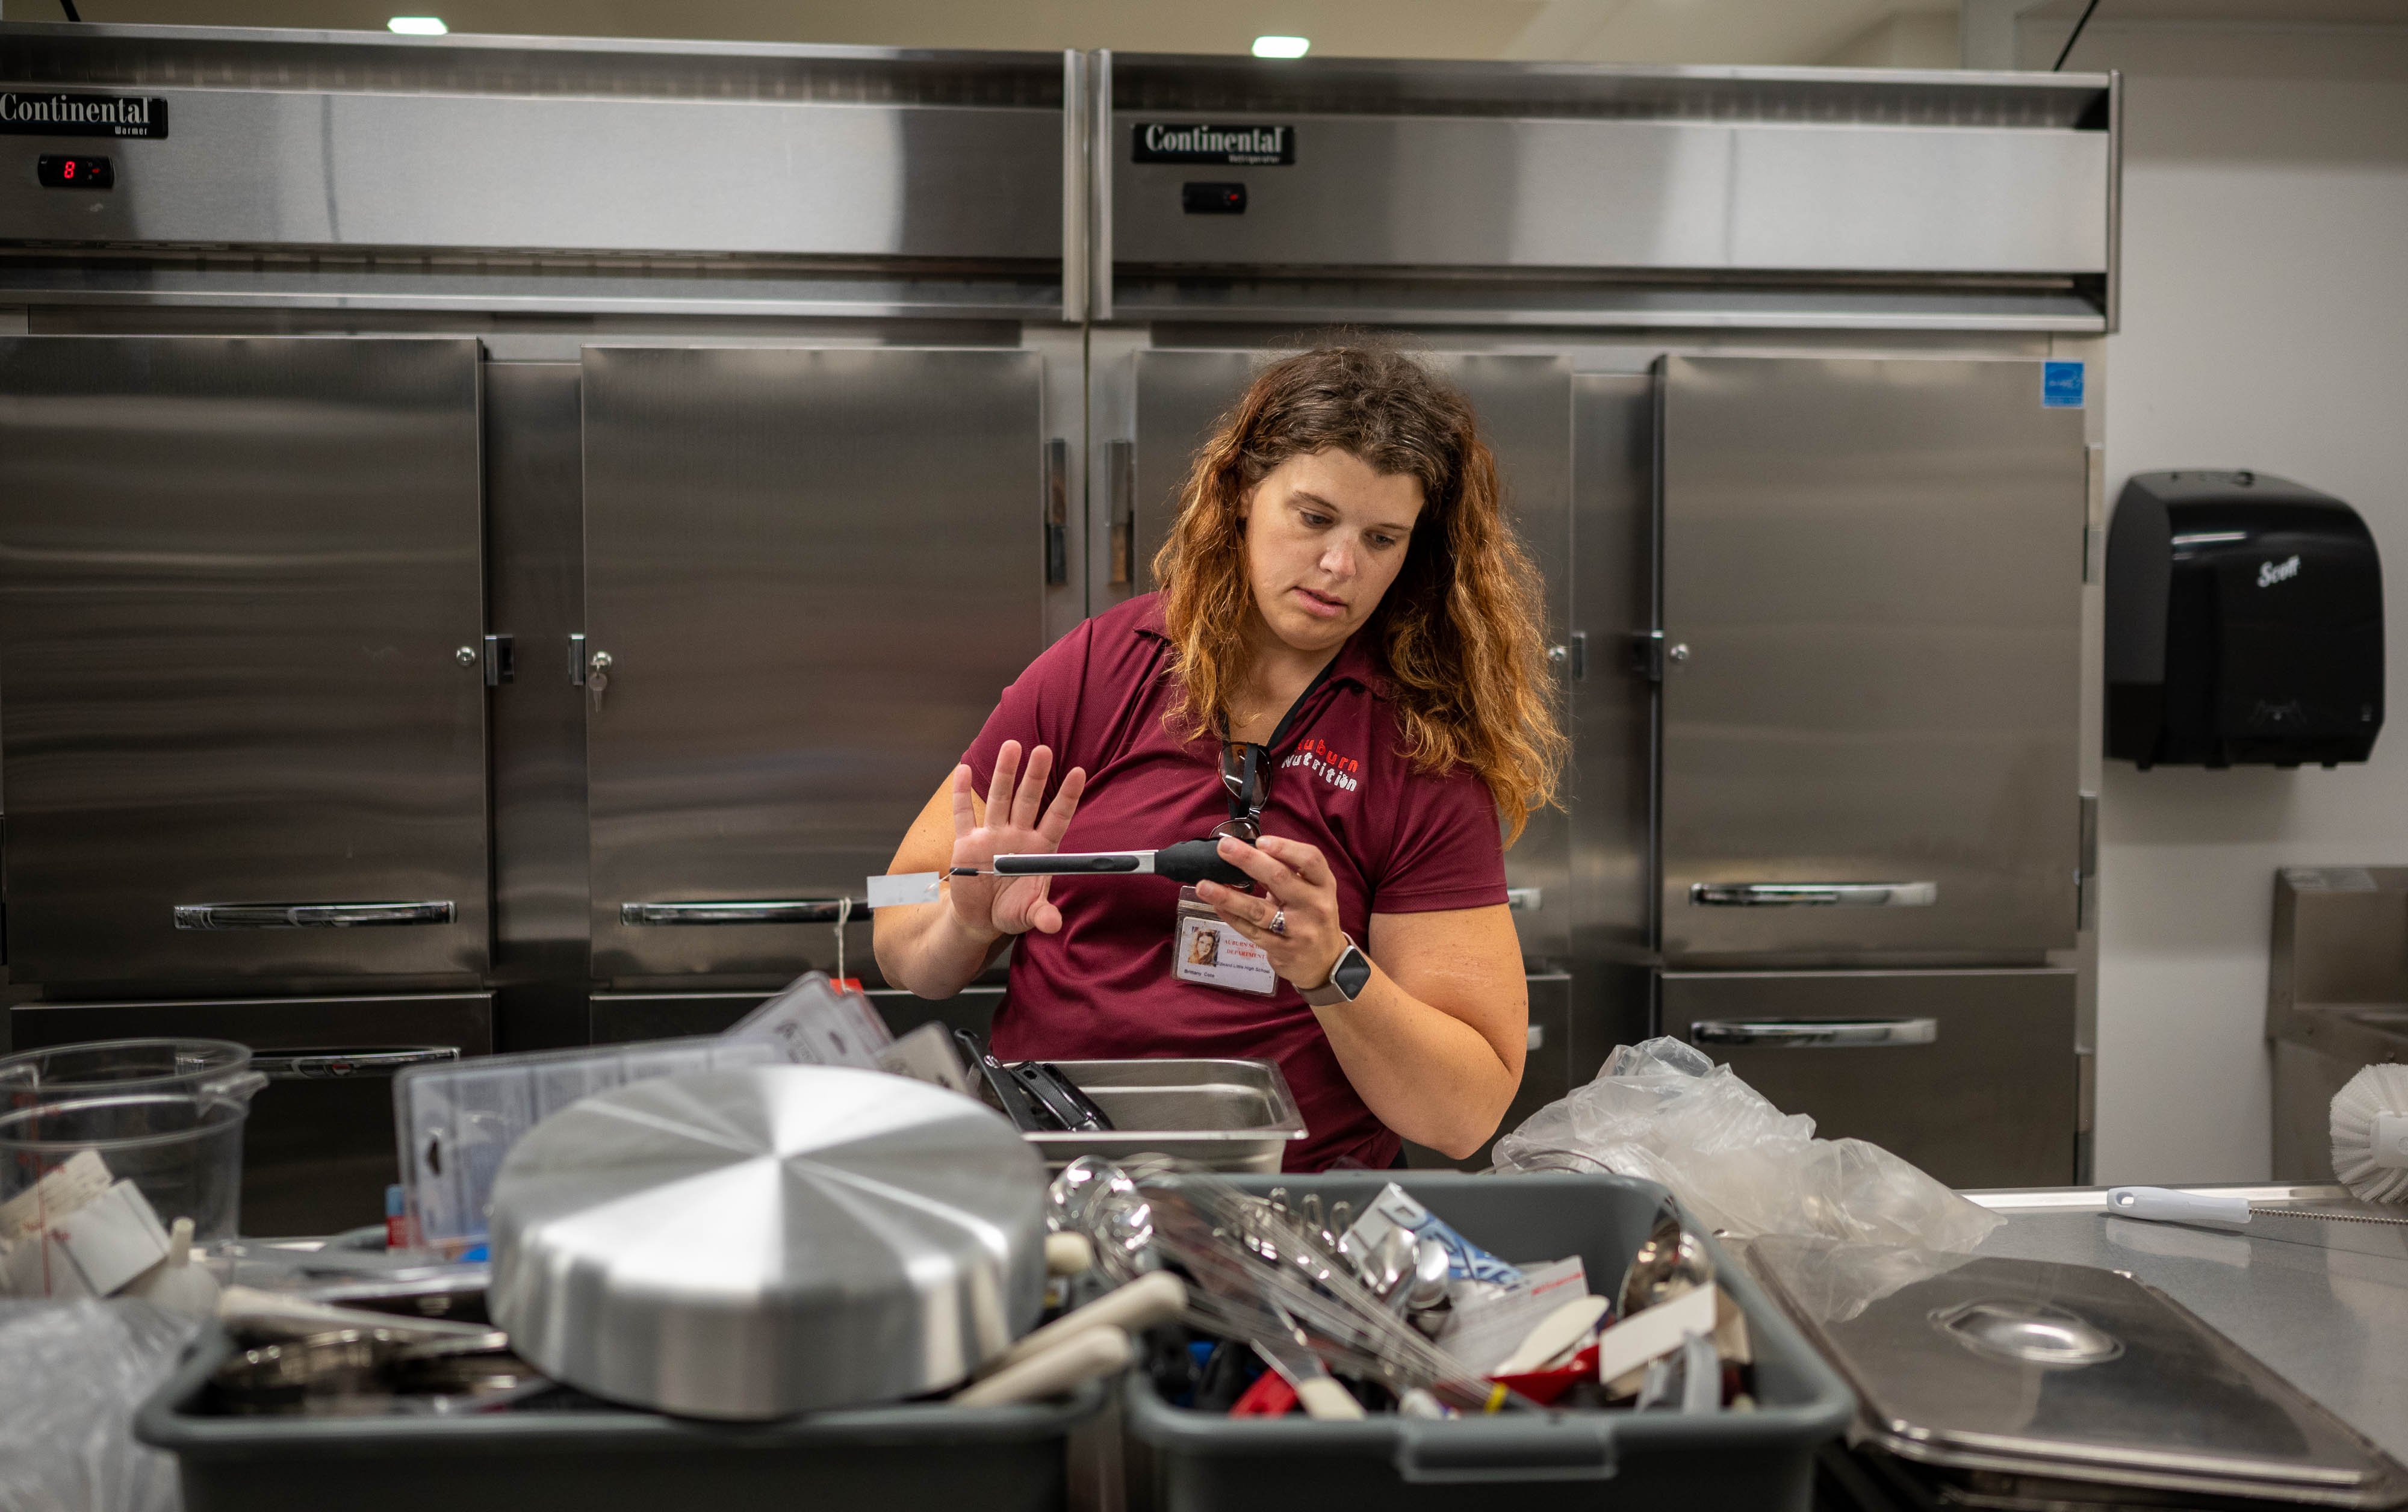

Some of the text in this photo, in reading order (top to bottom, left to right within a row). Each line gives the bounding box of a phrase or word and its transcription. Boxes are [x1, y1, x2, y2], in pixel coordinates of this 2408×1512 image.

[0, 93, 150, 124] Continental
[115, 126, 147, 135] Warmer
[1146, 124, 1284, 153] Continental
[63, 161, 75, 179] 8
[1281, 752, 1357, 792] Nutrition
[1227, 949, 1265, 959] DEPARTMENT
